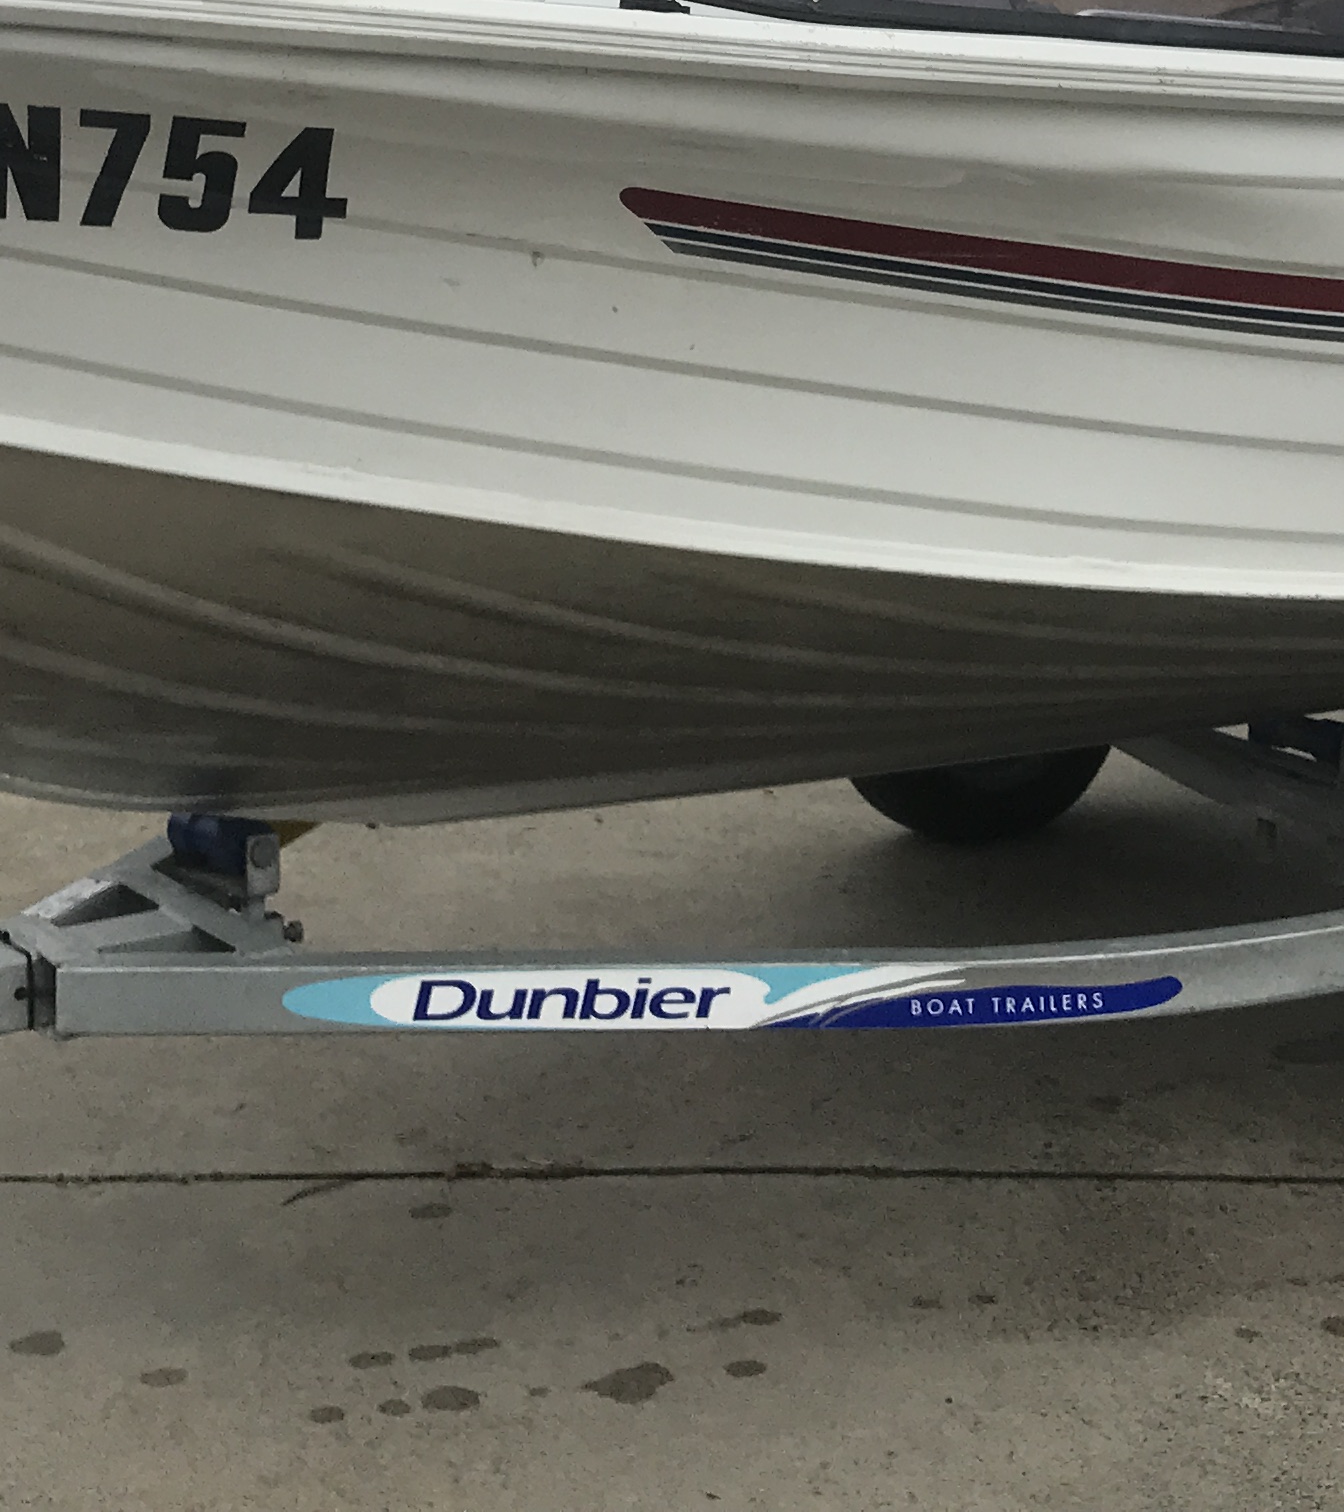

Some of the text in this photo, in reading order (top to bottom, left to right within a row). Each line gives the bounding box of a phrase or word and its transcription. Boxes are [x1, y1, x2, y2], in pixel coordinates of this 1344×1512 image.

[412, 978, 731, 1021] Dunbier
[910, 992, 1105, 1016] BOAT TRAILERS
